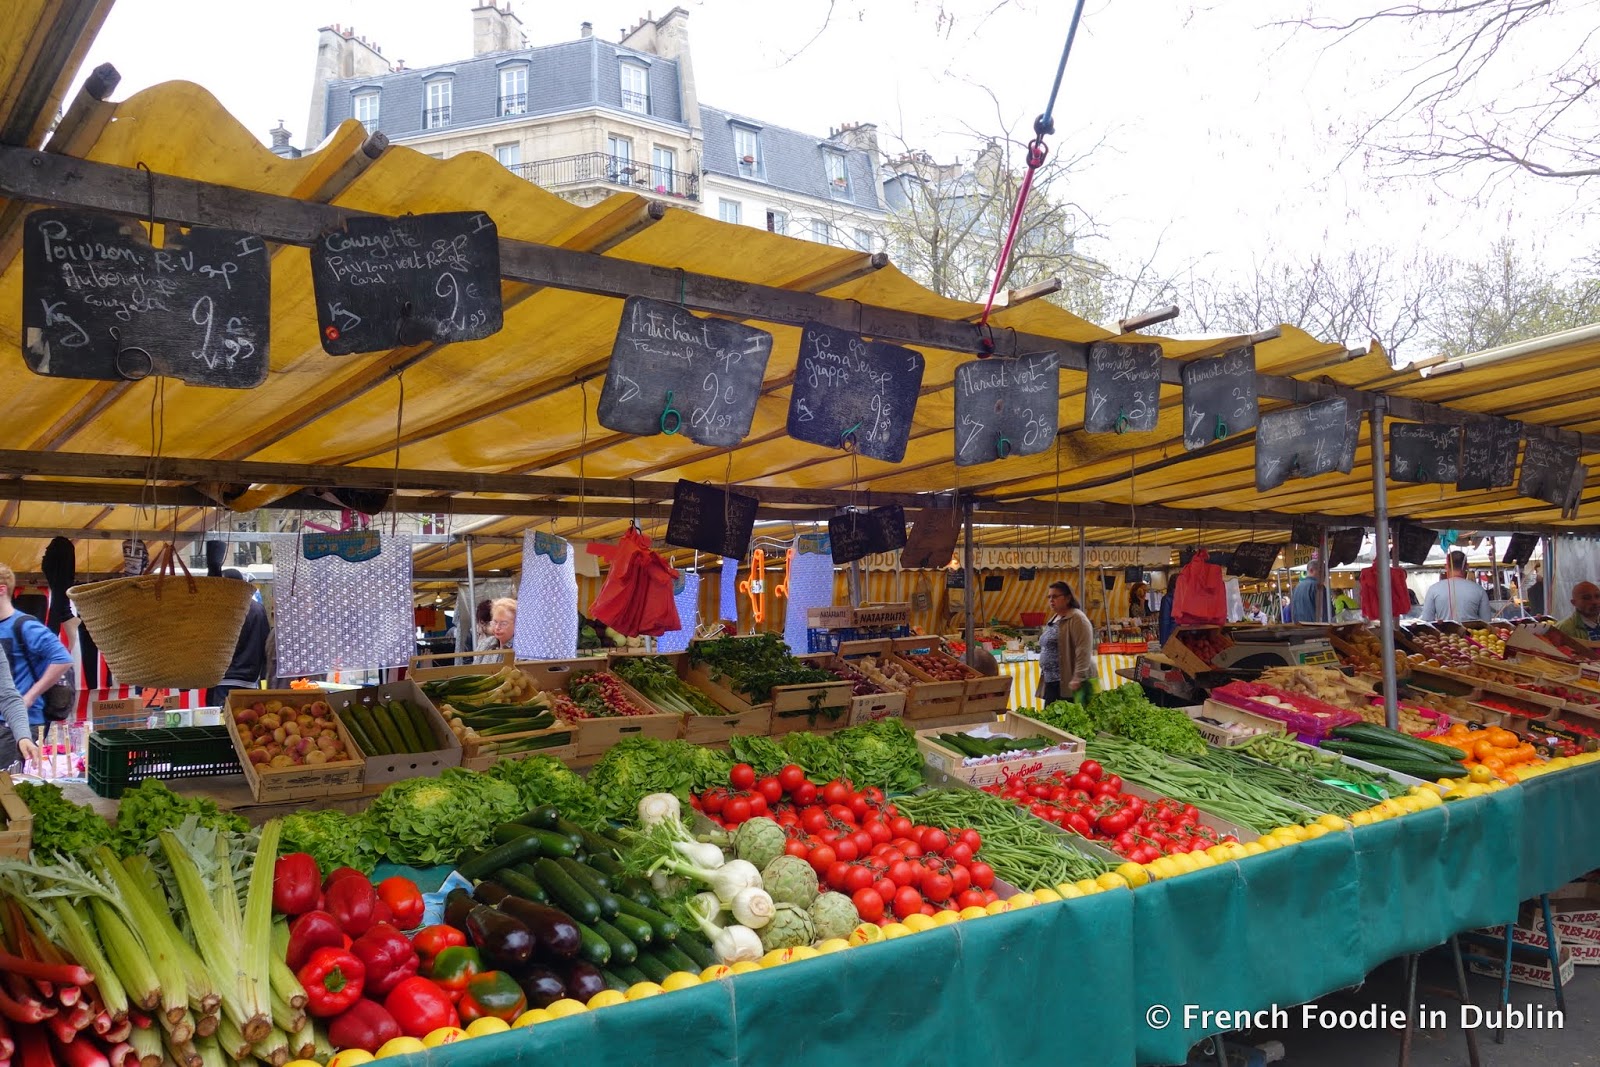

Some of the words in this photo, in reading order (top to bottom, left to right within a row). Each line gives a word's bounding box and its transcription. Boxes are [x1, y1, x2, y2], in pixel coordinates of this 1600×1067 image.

[988, 550, 1073, 565] L'AGRICULTURE
[1083, 549, 1141, 566] IOLOGIQUE
[1294, 549, 1312, 557] FRUIT
[860, 612, 906, 622] NATAFRUITS
[1571, 912, 1600, 922] FRES-
